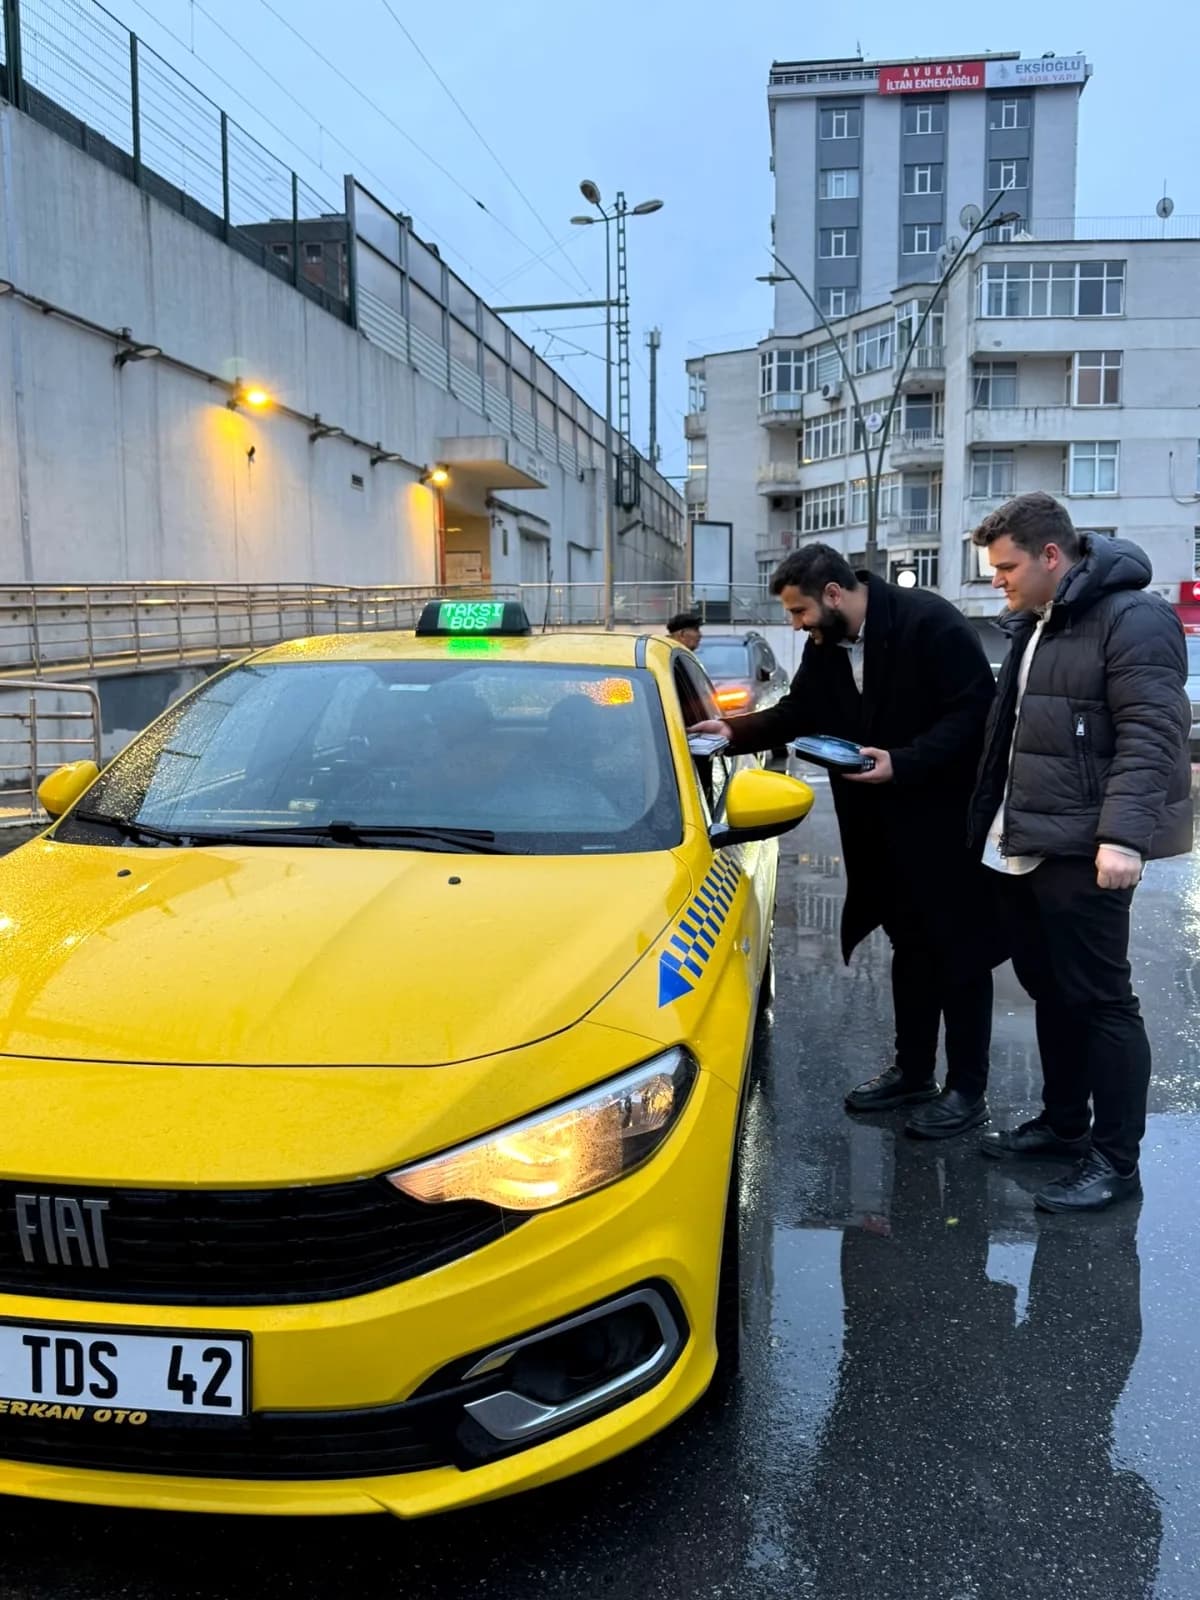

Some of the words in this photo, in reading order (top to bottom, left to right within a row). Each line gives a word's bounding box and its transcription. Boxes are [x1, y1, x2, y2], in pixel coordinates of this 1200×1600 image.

[903, 65, 963, 78] AVUKAT
[886, 78, 913, 91] İLTAN
[915, 74, 980, 89] EKMEKÇİOĞLU
[444, 603, 502, 617] TAKSI
[449, 616, 488, 630] BOS
[15, 1194, 110, 1269] FIAT
[22, 1335, 118, 1400] TDS
[167, 1345, 232, 1408] 42
[93, 1408, 148, 1425] OTO
